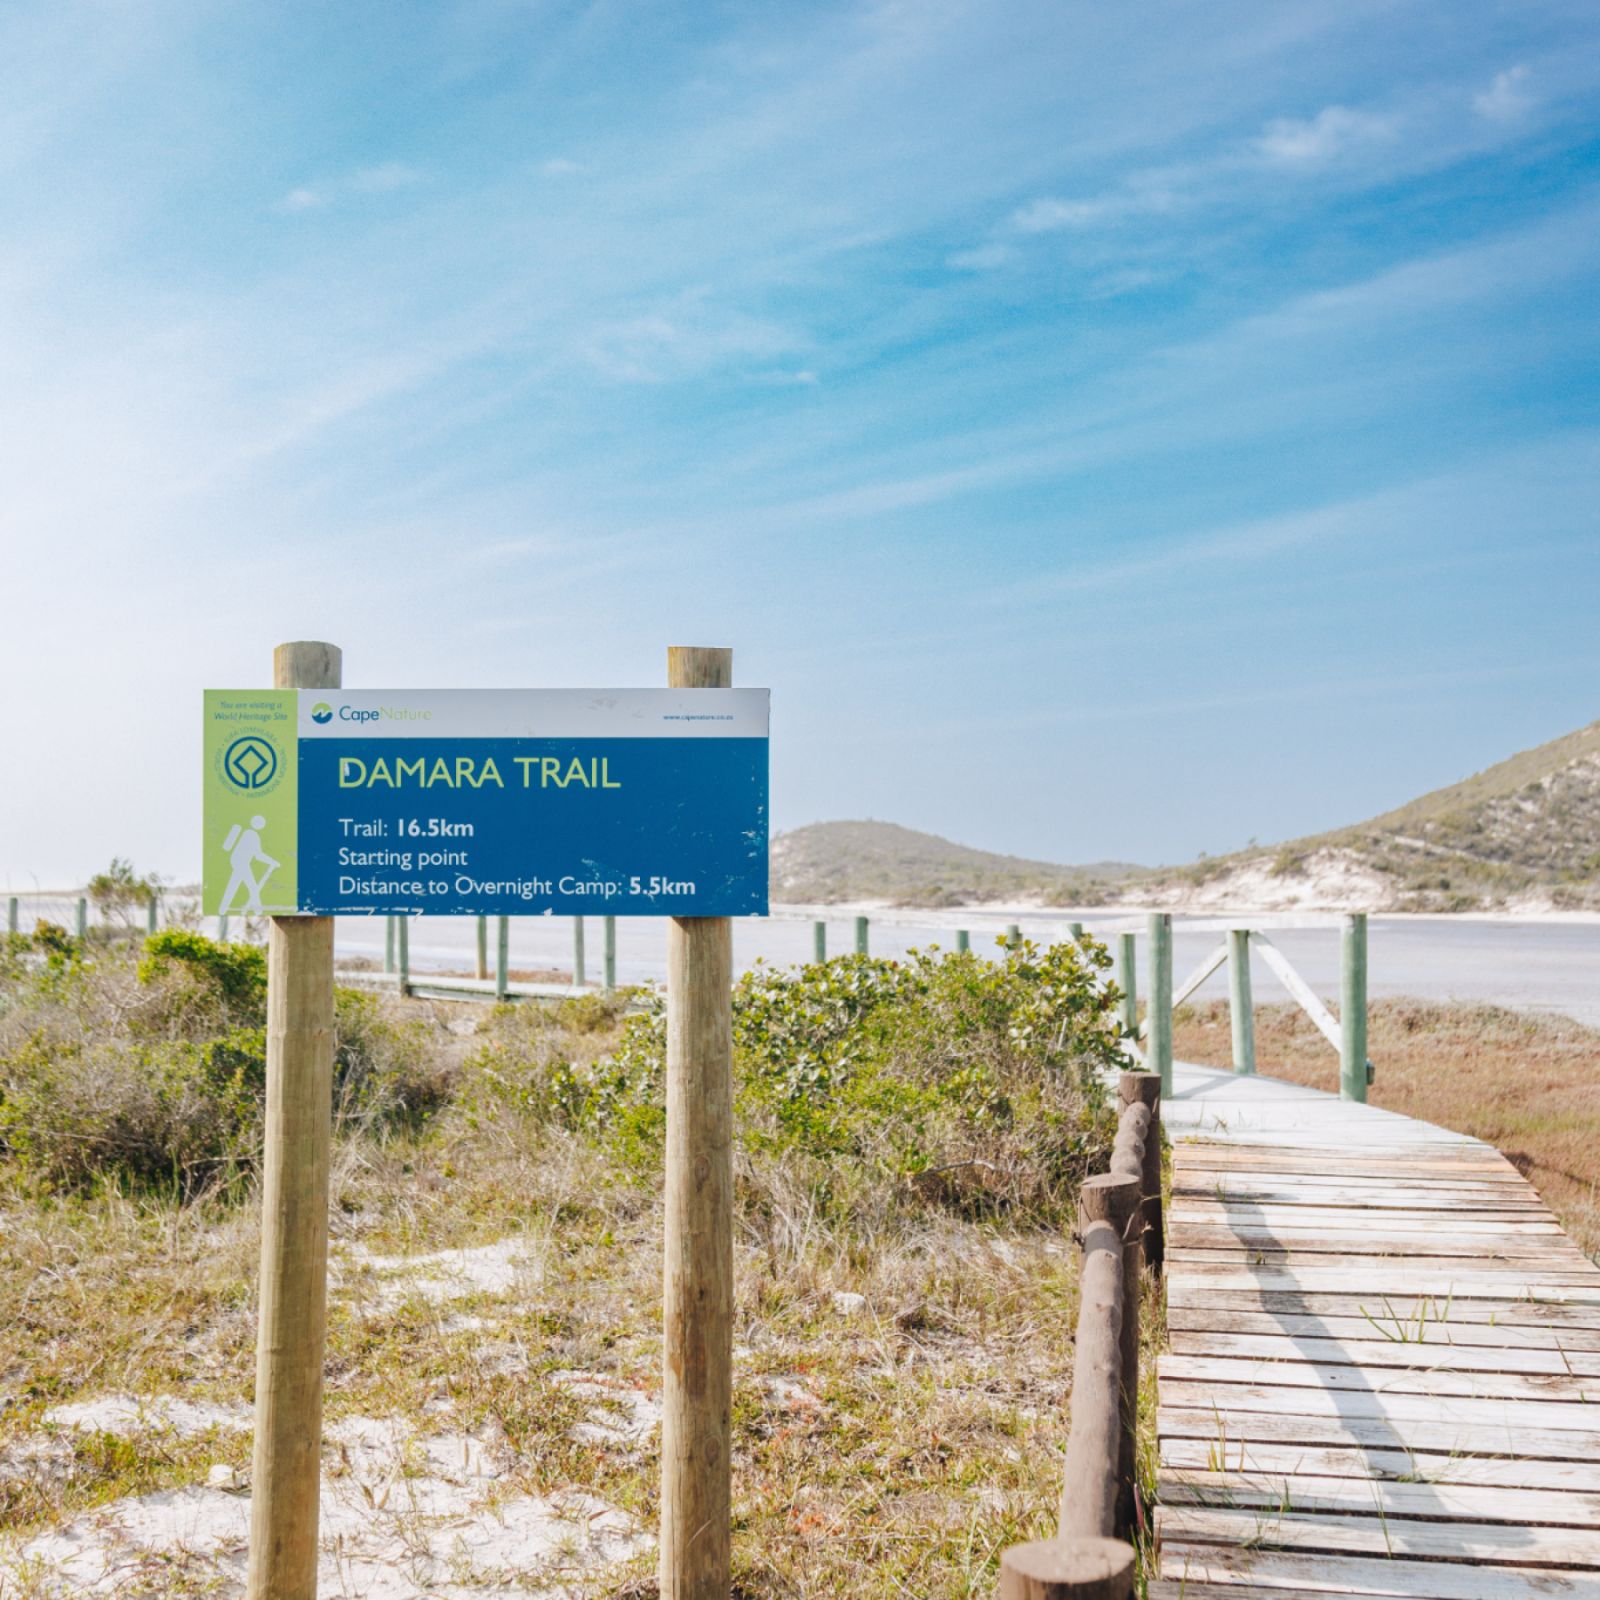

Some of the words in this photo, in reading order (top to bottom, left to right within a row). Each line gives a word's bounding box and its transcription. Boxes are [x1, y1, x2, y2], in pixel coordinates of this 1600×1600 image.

[338, 705, 433, 725] CapeNature
[339, 757, 505, 788] DAMARA
[513, 757, 622, 788] TRAIL
[338, 818, 388, 837] Trail:
[398, 818, 474, 837] 16.5km
[338, 847, 412, 871] Starting
[418, 849, 468, 871] point
[339, 876, 423, 895] Distance
[428, 879, 449, 895] to
[455, 876, 553, 900] Overnight
[558, 876, 623, 901] Camp:
[629, 876, 696, 895] 5.5km
